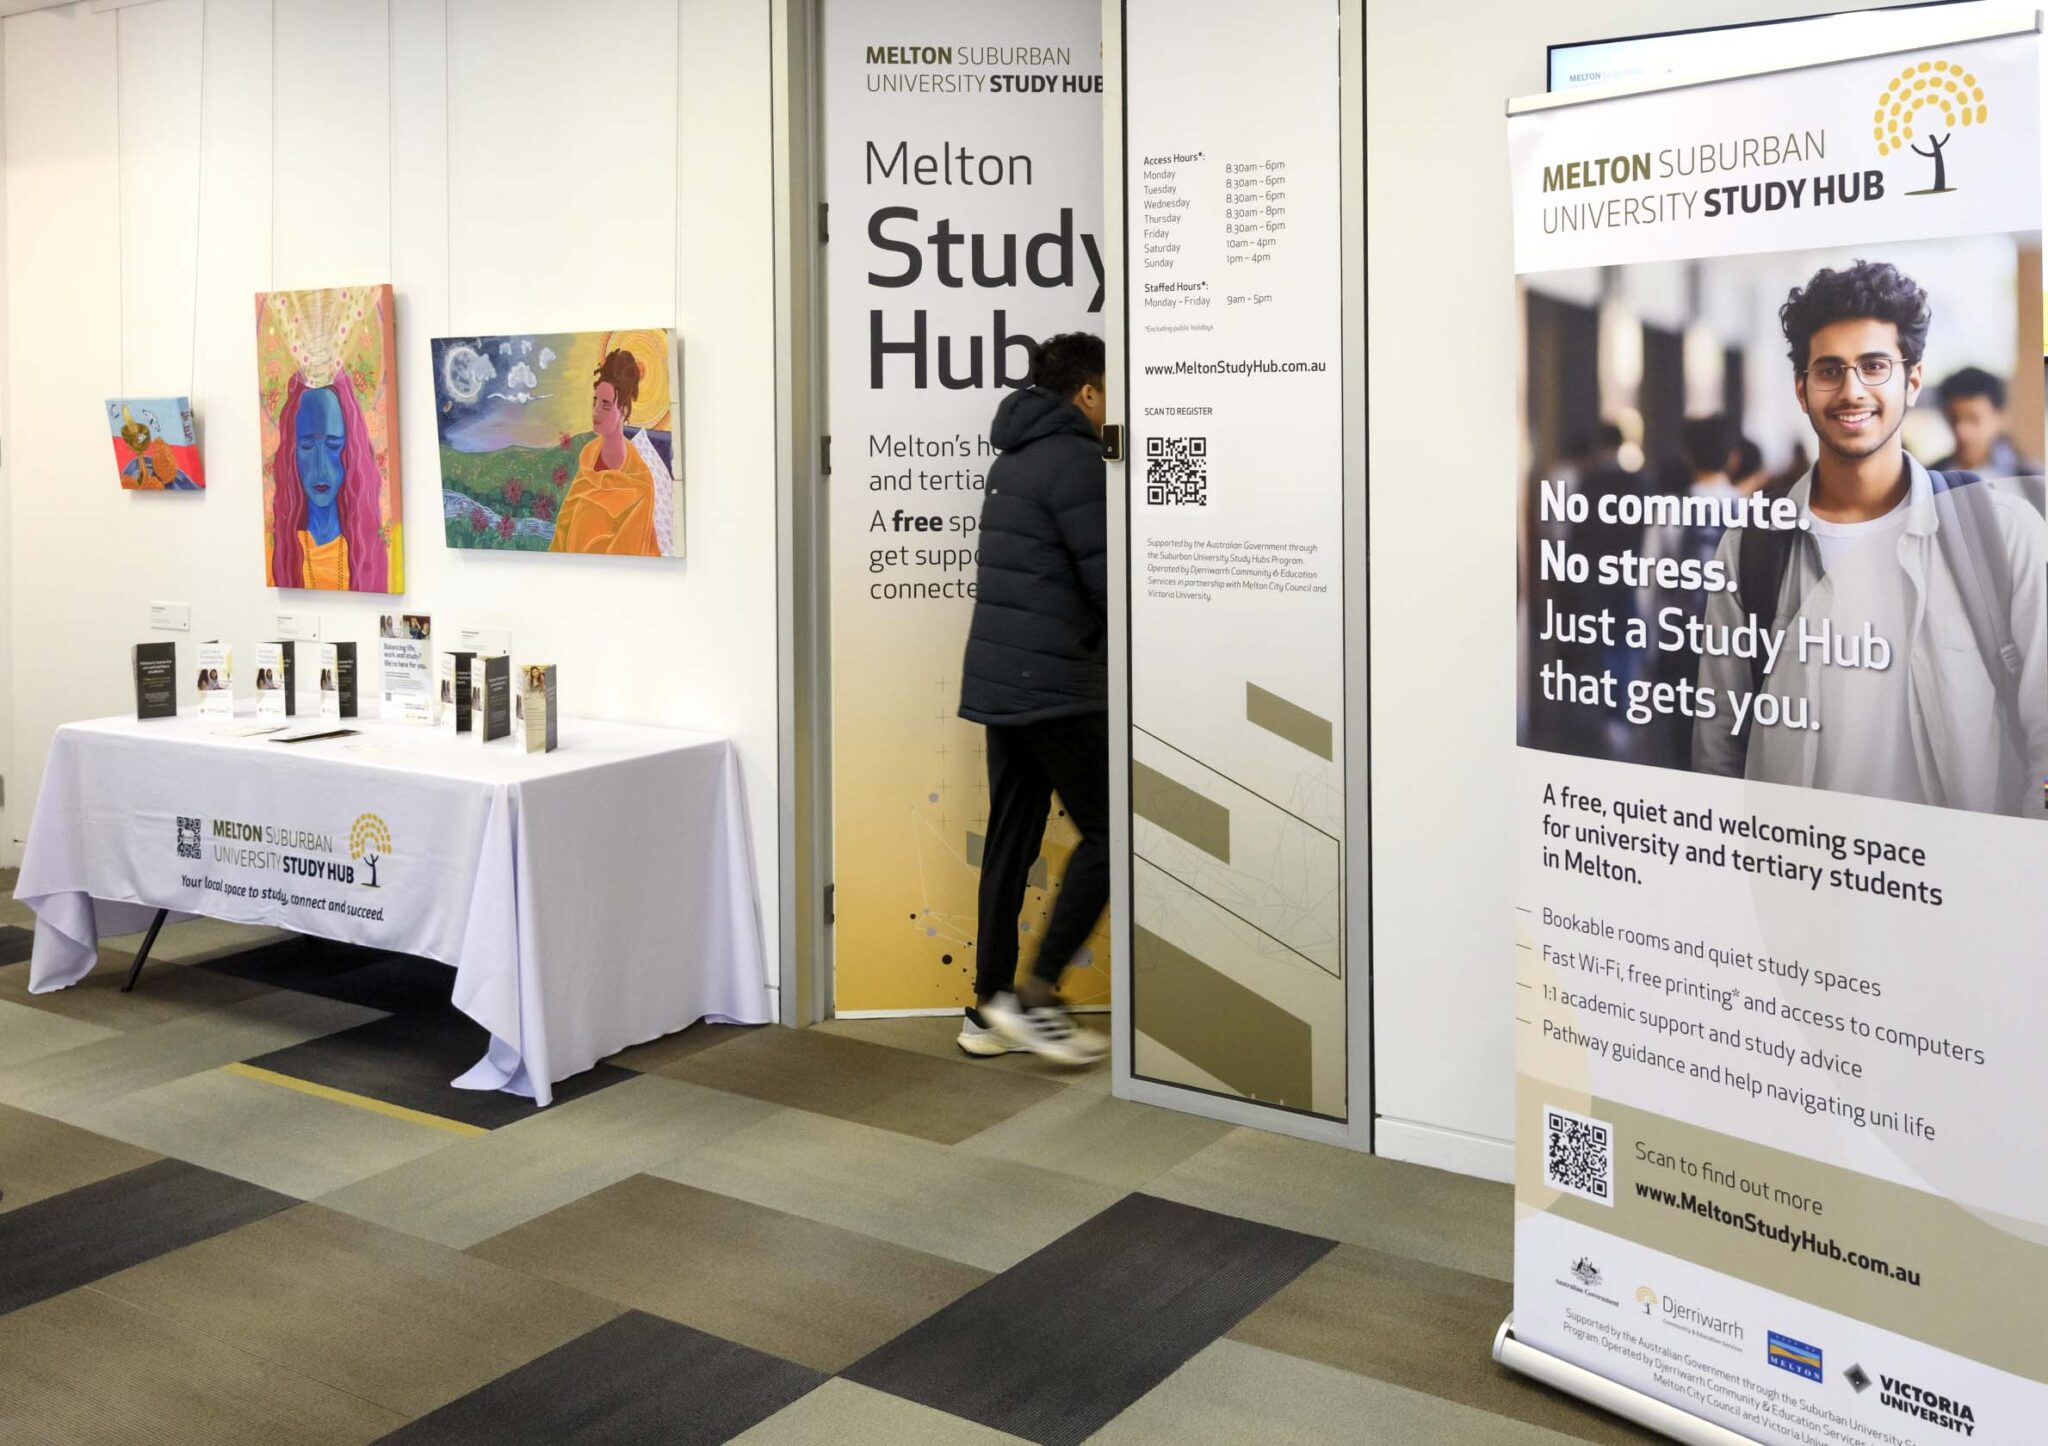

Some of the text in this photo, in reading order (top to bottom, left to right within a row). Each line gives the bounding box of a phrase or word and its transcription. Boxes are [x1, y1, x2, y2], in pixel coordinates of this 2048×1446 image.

[866, 46, 1070, 65] MELTON SUBURBAN
[867, 74, 985, 93] UNIVERSITY
[990, 75, 1058, 93] STUDY
[1569, 72, 1601, 82] MELTON
[866, 141, 1032, 186] Melton
[1144, 156, 1171, 165] Access
[1144, 160, 1285, 180] Monday 8.30am 6pm
[1542, 129, 1825, 192] MELTON SUBURBAN
[1144, 176, 1285, 195] Tuesday 8.30am 6pm
[1144, 190, 1285, 209] Wednesday 8.30am 6pm
[1543, 170, 1884, 234] UNIVERSITY STUDY HUB
[1144, 220, 1286, 240] Friday 8.30am 6pm
[1145, 206, 1285, 224] Thursday 8.30am 8pm
[868, 206, 1105, 313] Study
[1145, 238, 1276, 254] Saturday 10am 4pm
[1145, 253, 1270, 268] Sunday 1pm 4pm
[1144, 284, 1175, 292] Staffed
[1144, 294, 1272, 308] Monday Friday 9am 5pm
[870, 309, 1036, 390] Hub
[1145, 360, 1326, 377] www.MeltonStudyHub.com.au
[1144, 407, 1212, 416] SCAN TO REGISTER
[870, 434, 971, 457] Melton's
[870, 468, 984, 490] and tertia
[870, 510, 886, 532] A
[892, 510, 943, 532] free
[1540, 480, 1810, 530] No commute.
[870, 546, 908, 573] get
[1147, 538, 1318, 554] Supported by the Australian Government through
[1148, 552, 1158, 560] the
[1160, 552, 1192, 561] Suburban
[1194, 554, 1228, 564] University
[1230, 555, 1250, 564] Study
[1252, 556, 1270, 564] Hubs
[1540, 540, 1738, 592] No stress.
[870, 579, 978, 600] connecte
[1540, 598, 1891, 674] Just a Study Hub
[1540, 660, 1821, 736] that gets you.
[214, 820, 332, 853] MELTON SUBURBAN
[1543, 784, 1926, 866] A free, quiet and welcoming space
[214, 845, 354, 884] UNIVERSITY STUDY HUB
[1543, 814, 1942, 906] for university and tertiary students
[1543, 846, 1642, 884] in Melton.
[182, 874, 202, 888] Your
[205, 876, 222, 892] local
[224, 882, 246, 897] space
[249, 886, 258, 898] to
[290, 894, 326, 910] connect
[328, 900, 346, 912] and
[347, 905, 384, 921] succeed.
[1544, 907, 1881, 997] Bookable rooms and quiet study spaces
[1544, 945, 1575, 969] Fast
[1578, 952, 1624, 982] Wi-Fi,
[1628, 965, 1662, 988] free
[1744, 996, 1776, 1015] and
[1781, 1004, 1845, 1032] access
[1850, 1017, 1870, 1037] to
[1875, 1026, 1985, 1066] computers
[1542, 984, 1862, 1078] 1:1 academic support and study advice
[1544, 1020, 1936, 1140] Pathway guidance and help navigating uni life
[1635, 1141, 1823, 1216] Scan to find out more
[1636, 1181, 1920, 1287] www.MeltonStudyHub.com.au
[1584, 1288, 1619, 1308] Government
[1662, 1296, 1744, 1340] Djerriwarrh
[1566, 1308, 1780, 1402] Supported by the Australian Government through
[1770, 1356, 1820, 1380] MELTON
[1880, 1374, 1974, 1422] VICTORIA
[1880, 1393, 1974, 1436] UNIVERSITY
